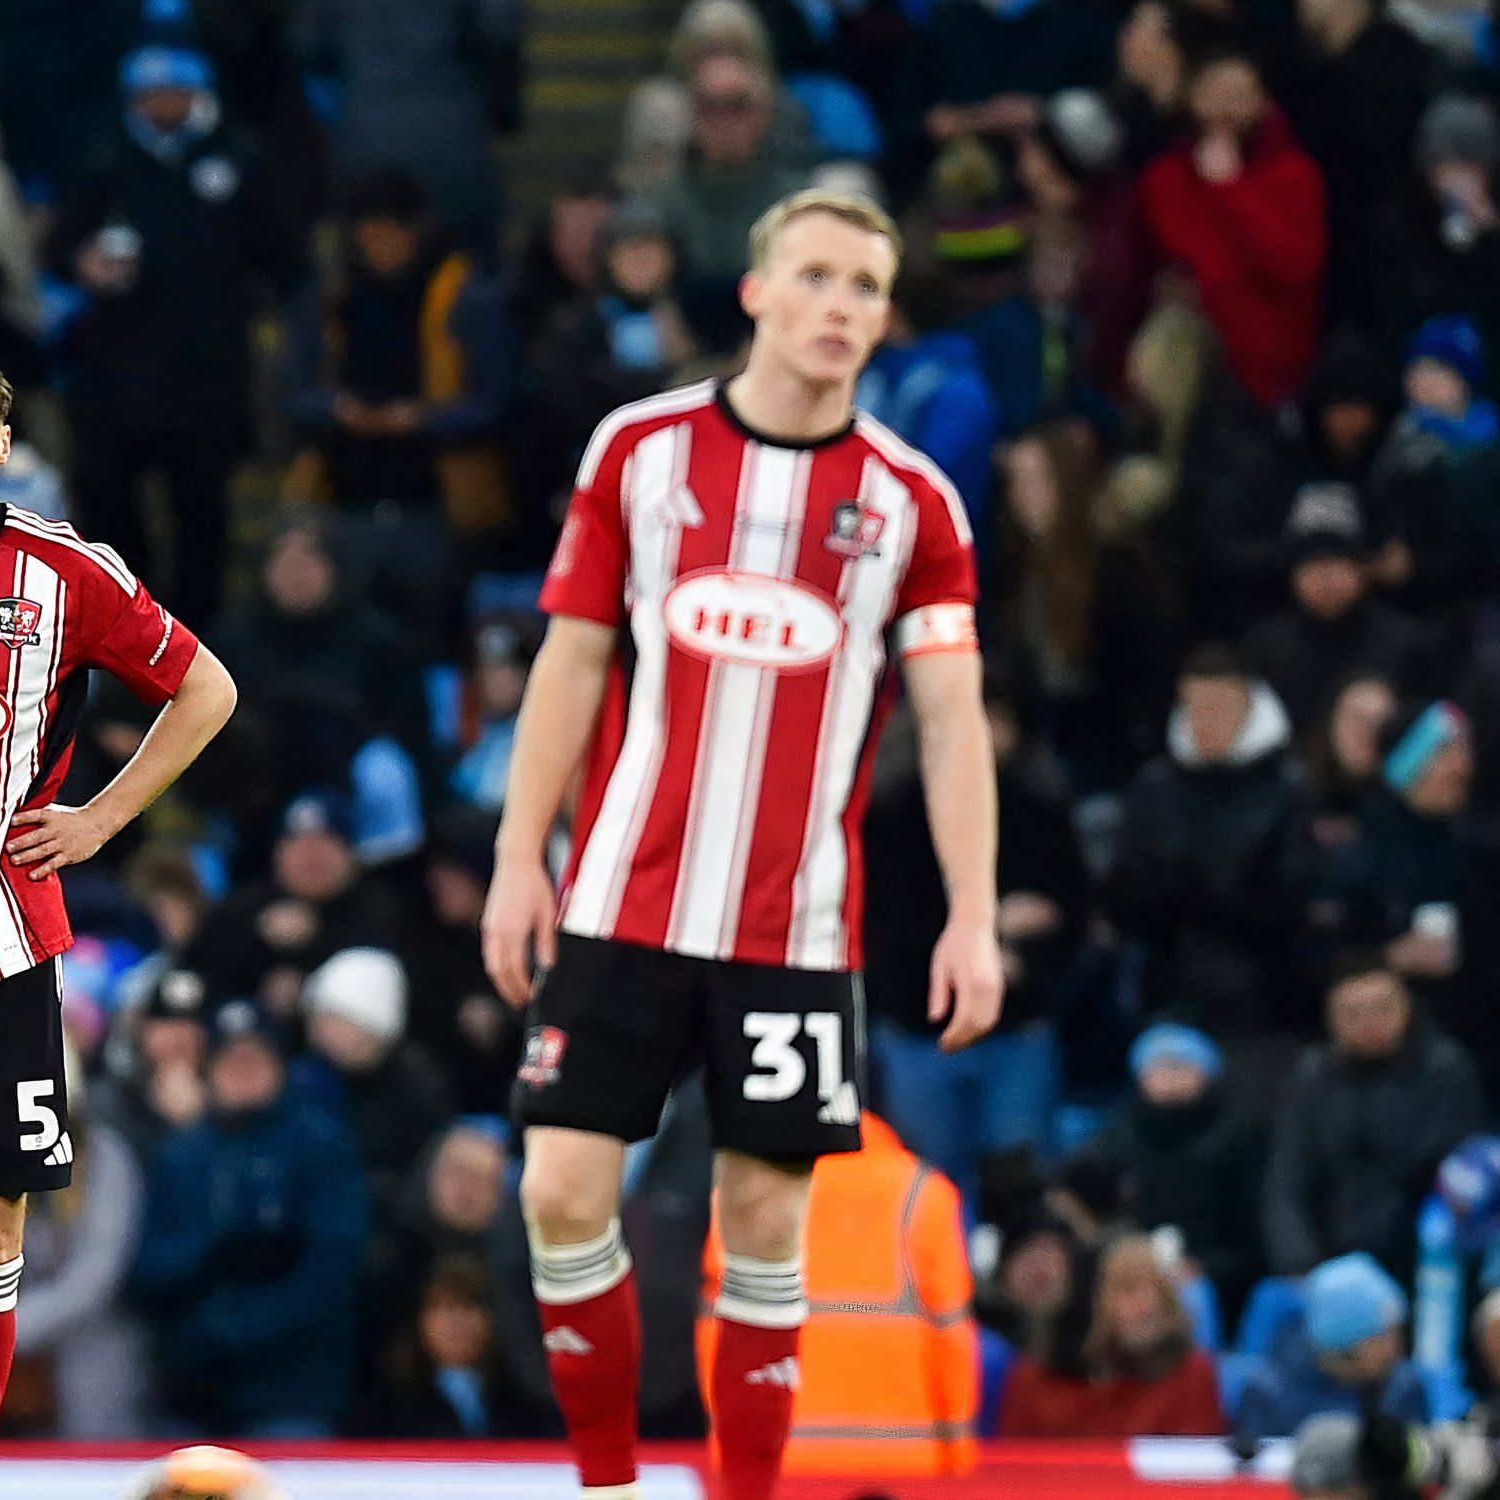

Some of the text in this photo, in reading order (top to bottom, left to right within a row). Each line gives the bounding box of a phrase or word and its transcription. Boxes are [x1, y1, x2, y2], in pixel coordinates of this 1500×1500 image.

[694, 607, 808, 654] HEL
[743, 1011, 843, 1102] 31
[17, 1079, 59, 1151] 5
